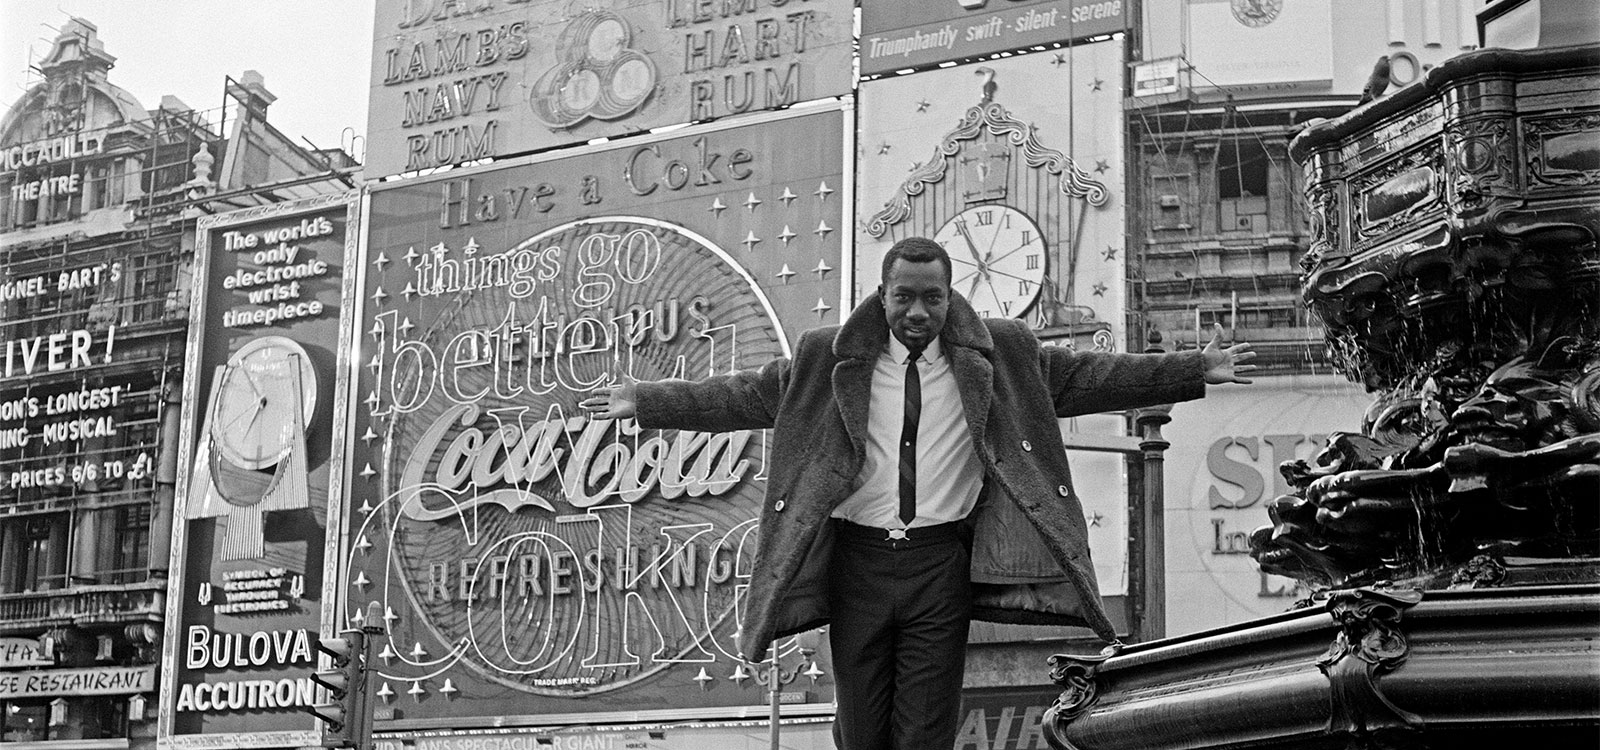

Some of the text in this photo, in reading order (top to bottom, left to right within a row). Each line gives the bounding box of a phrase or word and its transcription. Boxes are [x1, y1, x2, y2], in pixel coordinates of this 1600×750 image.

[684, 9, 815, 74] HART
[869, 25, 958, 58] Triumphantly
[966, 16, 1003, 42] swift
[1015, 8, 1058, 33] silent
[1071, 0, 1121, 23] serene
[384, 20, 529, 86] LAMB'S
[401, 71, 508, 128] NAVY
[690, 62, 801, 123] RUM
[405, 119, 498, 171] RUM
[11, 174, 80, 200] THEATRE
[440, 136, 754, 230] Have a Coke
[222, 216, 333, 252] The world's
[976, 210, 993, 227] XII
[254, 243, 300, 266] only
[1021, 231, 1030, 247] II
[58, 262, 121, 292] BART'S
[222, 258, 328, 290] electronic
[415, 229, 661, 307] things go
[1026, 254, 1039, 270] III
[248, 280, 300, 304] wrist
[1018, 280, 1032, 297] IV
[222, 299, 324, 328] timepiece
[1003, 301, 1012, 316] V
[471, 295, 711, 364] DELICIOUS
[0, 325, 115, 378] IVER!
[371, 295, 654, 417] better
[0, 385, 122, 421] ON'S LONGEST
[43, 415, 117, 444] MUSICAL
[11, 452, 152, 489] PRICES 6/6 TO £1
[400, 402, 753, 522] Coca-Cola
[346, 482, 800, 681] Coke
[428, 539, 733, 601] REFRESHING
[186, 625, 312, 669] BULOVA
[25, 670, 148, 693] RESTAURANT
[176, 678, 315, 712] ACCUTRON
[400, 739, 450, 750] LAN'S
[456, 735, 562, 750] SPECTACULR
[953, 706, 1049, 750] AIR
